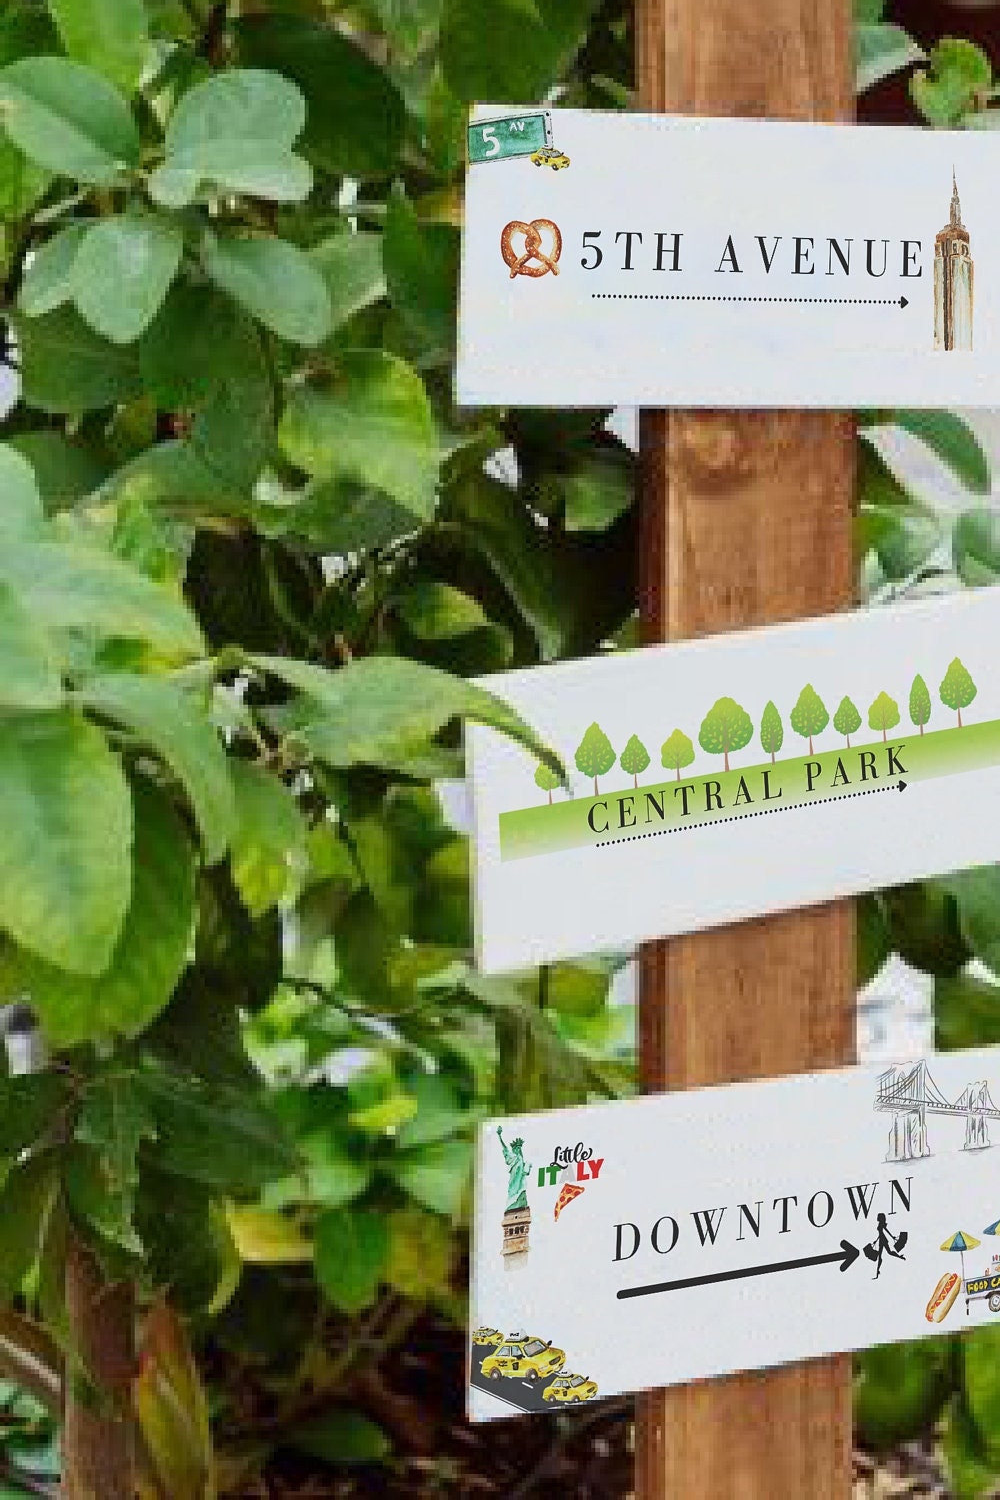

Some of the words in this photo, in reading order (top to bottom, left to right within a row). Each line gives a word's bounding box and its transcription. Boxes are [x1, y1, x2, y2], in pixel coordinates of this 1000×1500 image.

[482, 126, 501, 157] 5
[509, 121, 525, 132] AV
[580, 230, 684, 273] 5TH
[714, 234, 924, 278] AVENUE
[587, 770, 783, 834] CENTRAL
[804, 744, 910, 793] PARK
[537, 1158, 605, 1188] ITALY
[550, 1141, 593, 1169] Little
[612, 1176, 914, 1262] DOWNTOWN
[967, 1280, 988, 1295] FOOD
